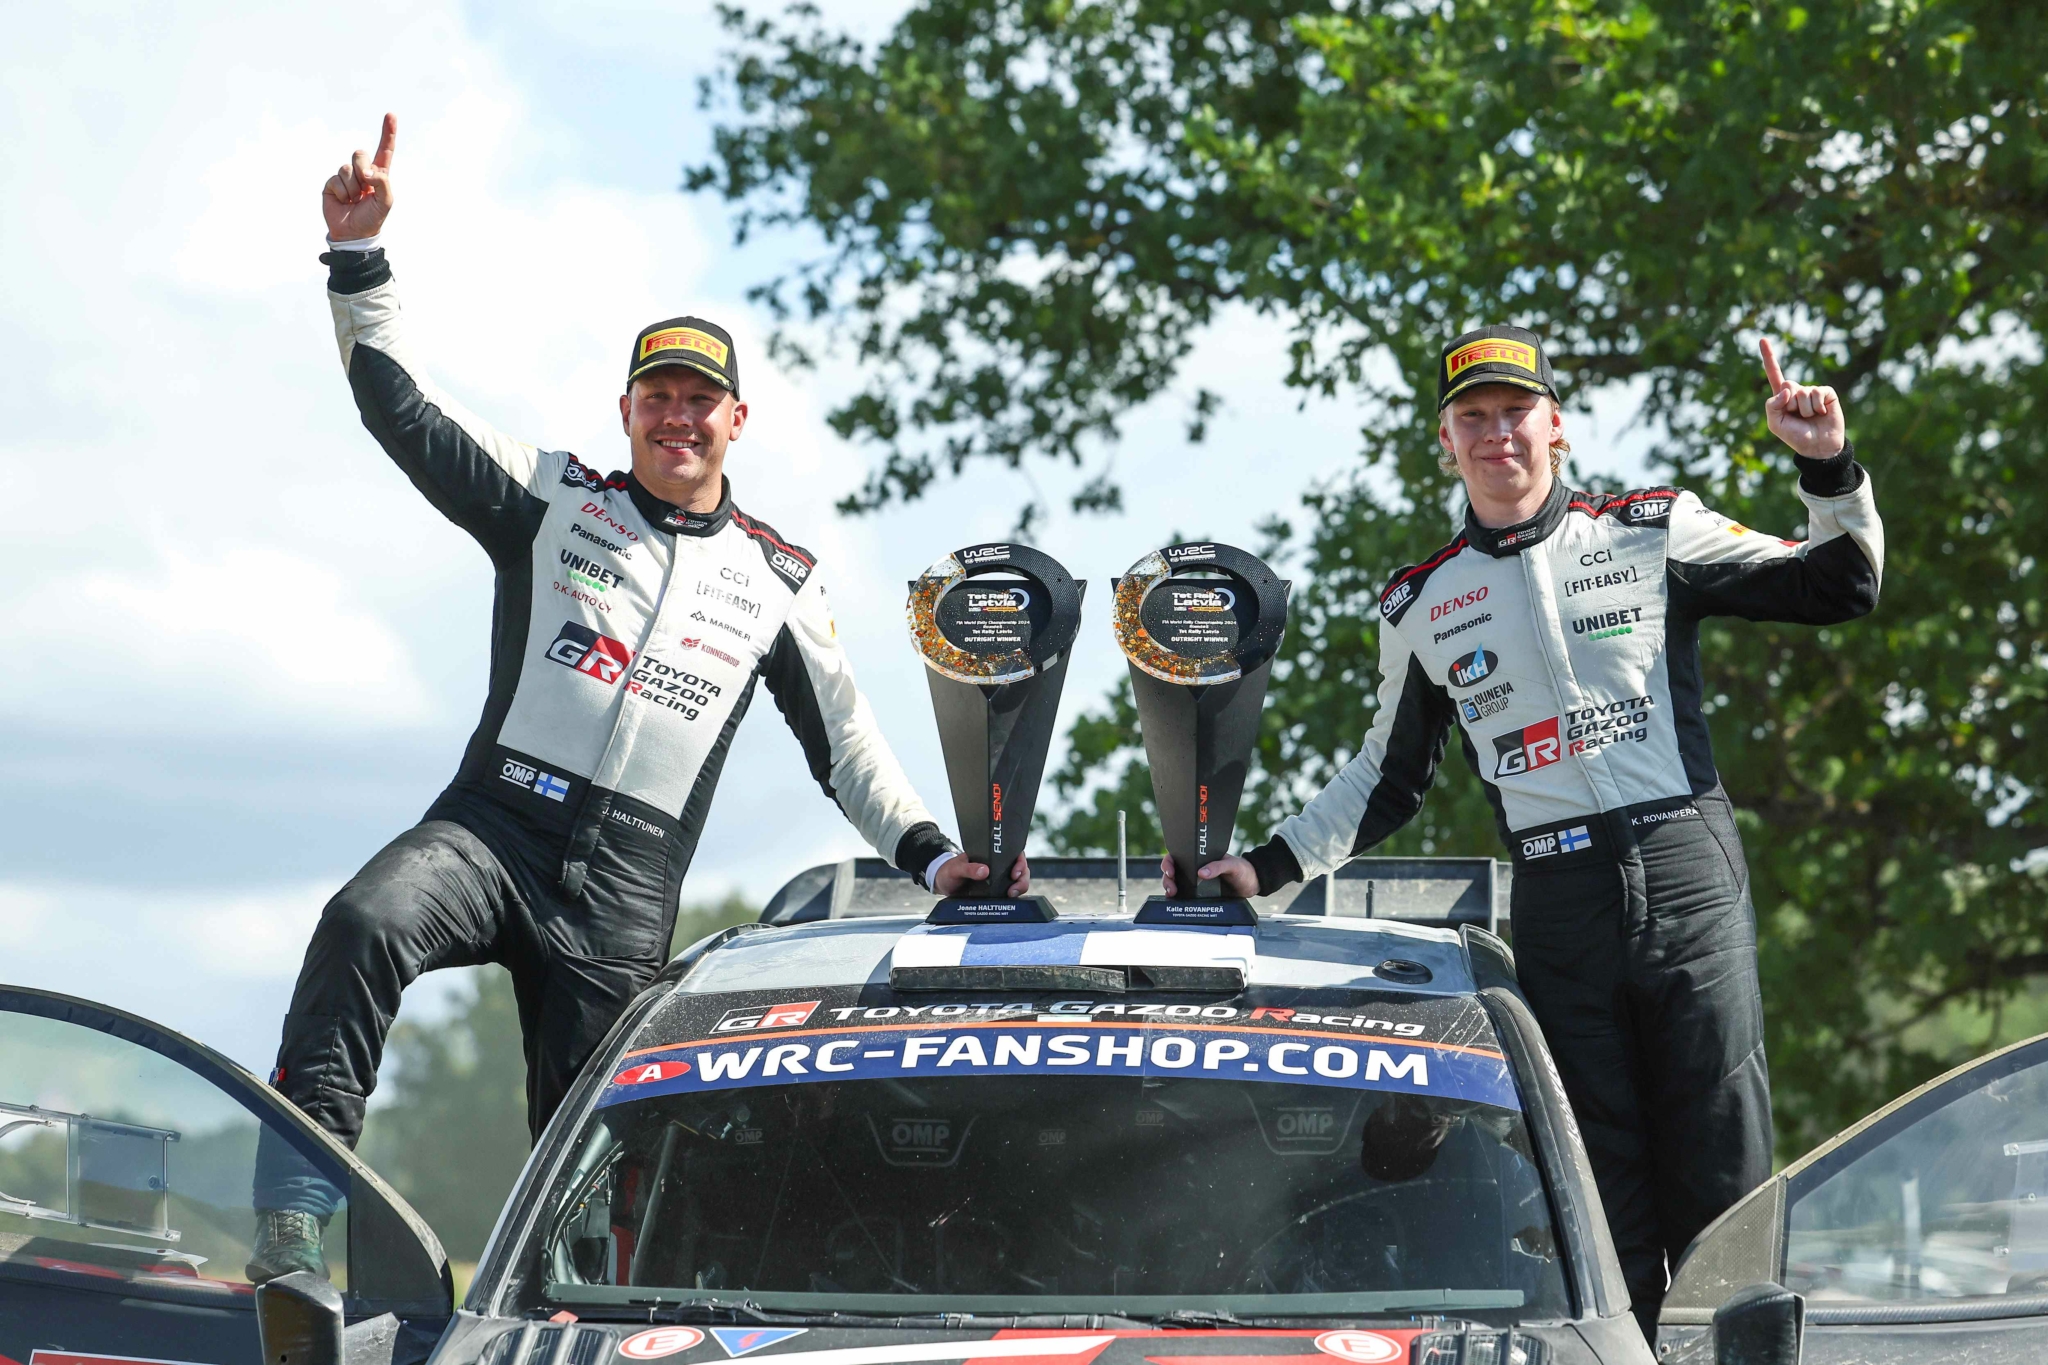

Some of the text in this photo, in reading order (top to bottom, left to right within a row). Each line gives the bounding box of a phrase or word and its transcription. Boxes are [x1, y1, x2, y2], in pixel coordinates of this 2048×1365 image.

[645, 331, 722, 359] PIRELLI
[1451, 343, 1530, 373] PIRELLI
[581, 502, 638, 541] DENSO
[1630, 502, 1669, 517] OMP
[570, 523, 632, 560] Panasonic
[963, 545, 1010, 558] WRC
[1168, 544, 1216, 557] WRC
[560, 549, 624, 588] UNIBET
[772, 553, 807, 579] OMP
[571, 590, 597, 606] AUTO
[968, 599, 1016, 607] Latvia
[988, 593, 1016, 601] Rally
[1193, 592, 1221, 600] Rally
[1382, 584, 1411, 614] OMP
[1430, 586, 1489, 622] DENSO
[709, 618, 751, 642] MARINE.FI
[1433, 613, 1492, 645] Panasonic
[1572, 607, 1642, 634] UNIBET
[549, 638, 624, 682] GR
[701, 643, 740, 668] KONNEGROUP
[631, 669, 709, 707] GAZOO
[642, 655, 722, 697] TOYOTA
[623, 680, 700, 721] Racing
[1474, 682, 1514, 705] OUNEVA
[1480, 697, 1509, 717] GROUP
[1566, 695, 1654, 725] TOYOTA
[1567, 711, 1648, 740] GAZOO
[1568, 727, 1648, 757] Racing
[1497, 736, 1559, 776] GR
[502, 762, 535, 785] OMP
[602, 806, 665, 839] J. HALTTUNEN
[1631, 817, 1642, 826] K.
[993, 823, 1002, 854] FULL
[1199, 825, 1207, 855] FULL
[1522, 837, 1557, 856] OMP
[718, 1001, 1426, 1036] GR TOYOTA GAZOO Racing
[636, 1064, 662, 1082] A
[697, 1034, 1430, 1086] WRC-FANSHOP.COM
[1136, 1113, 1164, 1124] OMP
[1277, 1113, 1333, 1135] OMP
[735, 1130, 763, 1143] OMP
[892, 1123, 949, 1147] OMP
[1038, 1131, 1066, 1144] OMP
[644, 1334, 678, 1351] E
[1341, 1339, 1376, 1354] E
